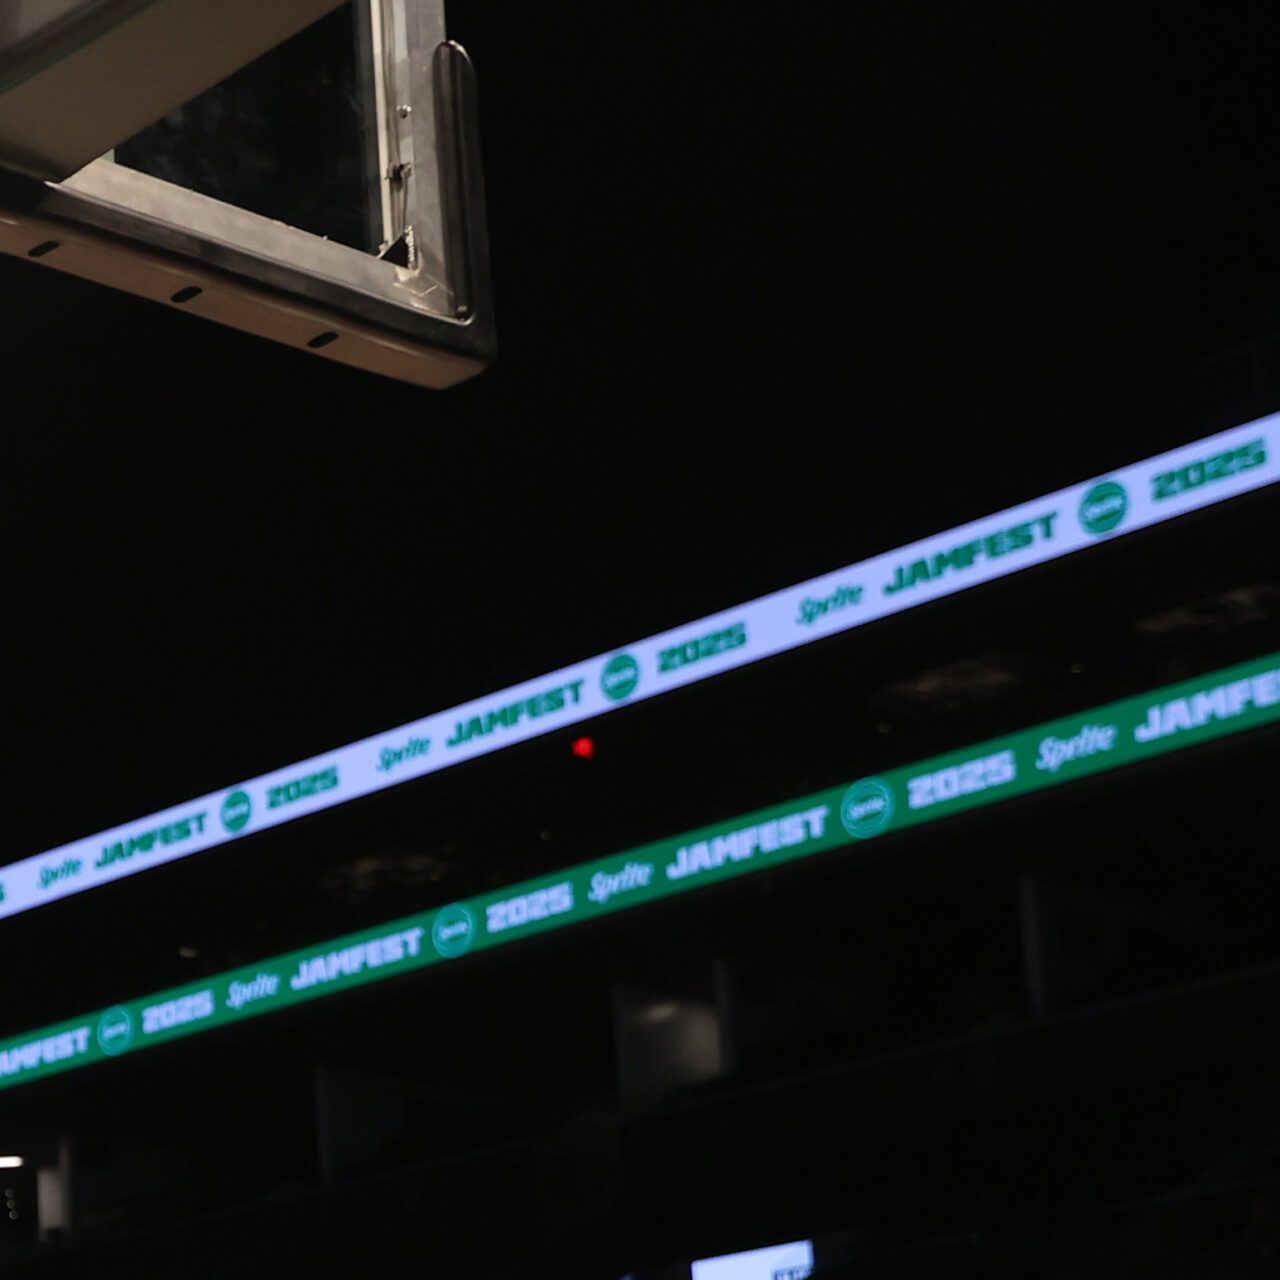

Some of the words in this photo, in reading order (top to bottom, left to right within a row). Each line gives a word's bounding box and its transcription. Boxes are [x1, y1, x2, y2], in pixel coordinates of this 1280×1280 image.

[1149, 437, 1267, 504] 2025
[656, 621, 746, 674] 2025
[796, 581, 864, 627] Sprite
[882, 511, 1058, 597] JAMFEST
[265, 765, 339, 810] 2025
[375, 732, 432, 774] Sprite
[445, 677, 584, 749] JAMFEST
[907, 749, 1016, 810] 2025
[1035, 720, 1118, 773] Sprite
[94, 811, 208, 870] JAMFEST
[486, 881, 574, 933] 2025
[587, 859, 654, 901] Sprite
[666, 803, 829, 878] JAMFEST
[141, 988, 214, 1034] 2025
[225, 970, 280, 1010] Sprite
[289, 926, 423, 991] JAMFEST
